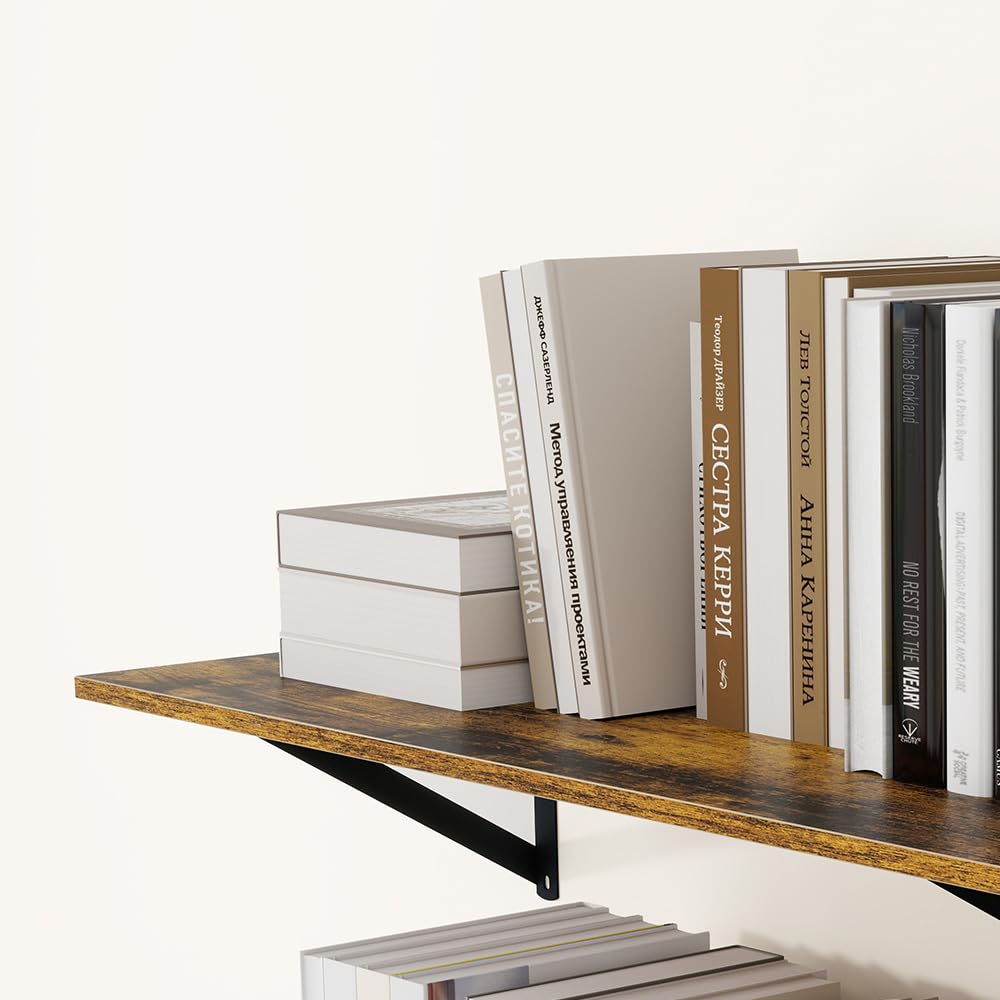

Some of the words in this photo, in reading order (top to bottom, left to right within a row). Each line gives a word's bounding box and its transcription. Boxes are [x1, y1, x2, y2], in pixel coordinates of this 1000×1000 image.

[533, 295, 546, 340] ДЖЕФФ
[541, 341, 555, 405] САЗЕРЛЕНД
[713, 315, 723, 357] Теодор
[902, 327, 919, 371] Nicholas
[713, 358, 724, 412] ДРАЙЗЕР
[902, 374, 919, 424] Brookland
[495, 372, 527, 497] СПАСИТЕ
[512, 504, 545, 625] КОТИКА!
[711, 423, 731, 536] СЕСТРА
[550, 422, 564, 479] Метод
[571, 593, 591, 686] проектами
[902, 561, 919, 577] NO
[713, 545, 733, 639] КЕРРИ
[902, 581, 919, 611] REST
[902, 614, 919, 638] FOR
[902, 641, 919, 662] THE
[903, 666, 920, 710] WEARY
